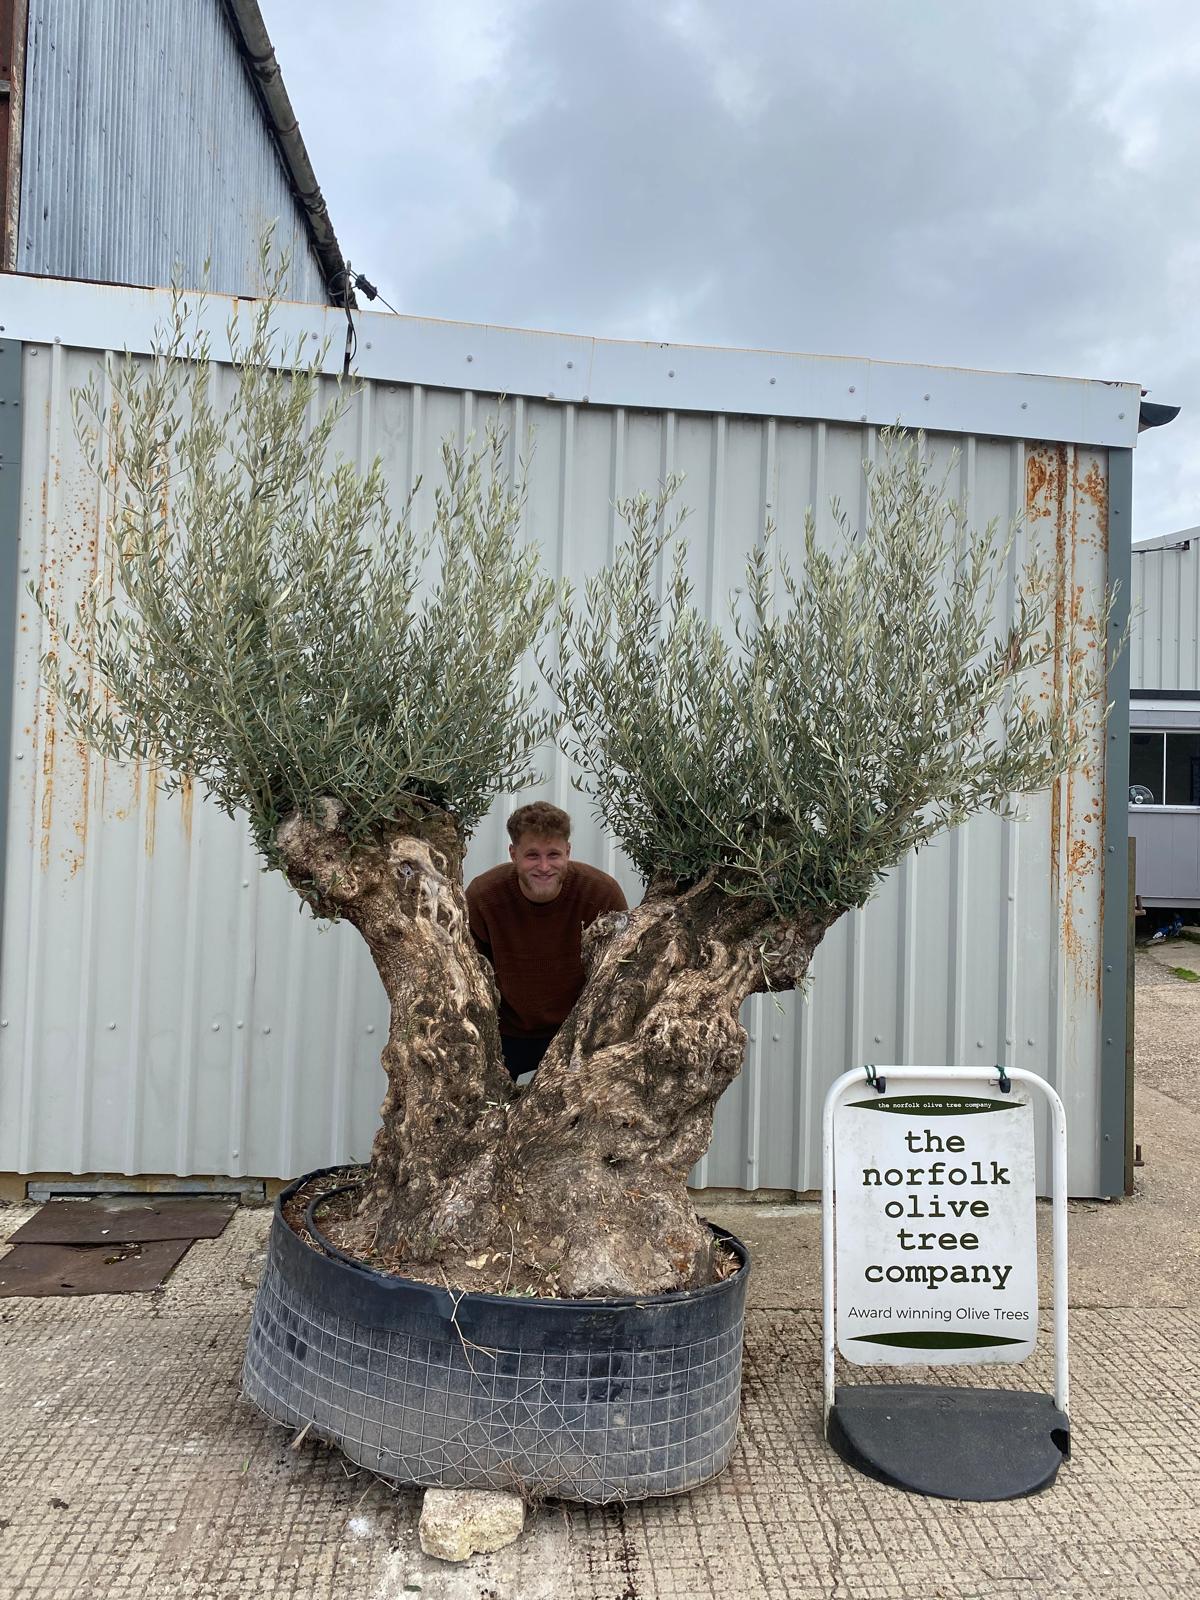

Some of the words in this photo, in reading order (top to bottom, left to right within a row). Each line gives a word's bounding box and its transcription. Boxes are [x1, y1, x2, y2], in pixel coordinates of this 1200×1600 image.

[904, 1129, 966, 1153] the
[862, 1161, 1011, 1186] norfolk
[885, 1195, 990, 1218] olive
[896, 1228, 979, 1251] tree
[864, 1264, 1013, 1290] company
[848, 1307, 892, 1319] Award
[896, 1307, 952, 1322] winning
[956, 1307, 990, 1320] Olive
[994, 1308, 1030, 1321] Trees
